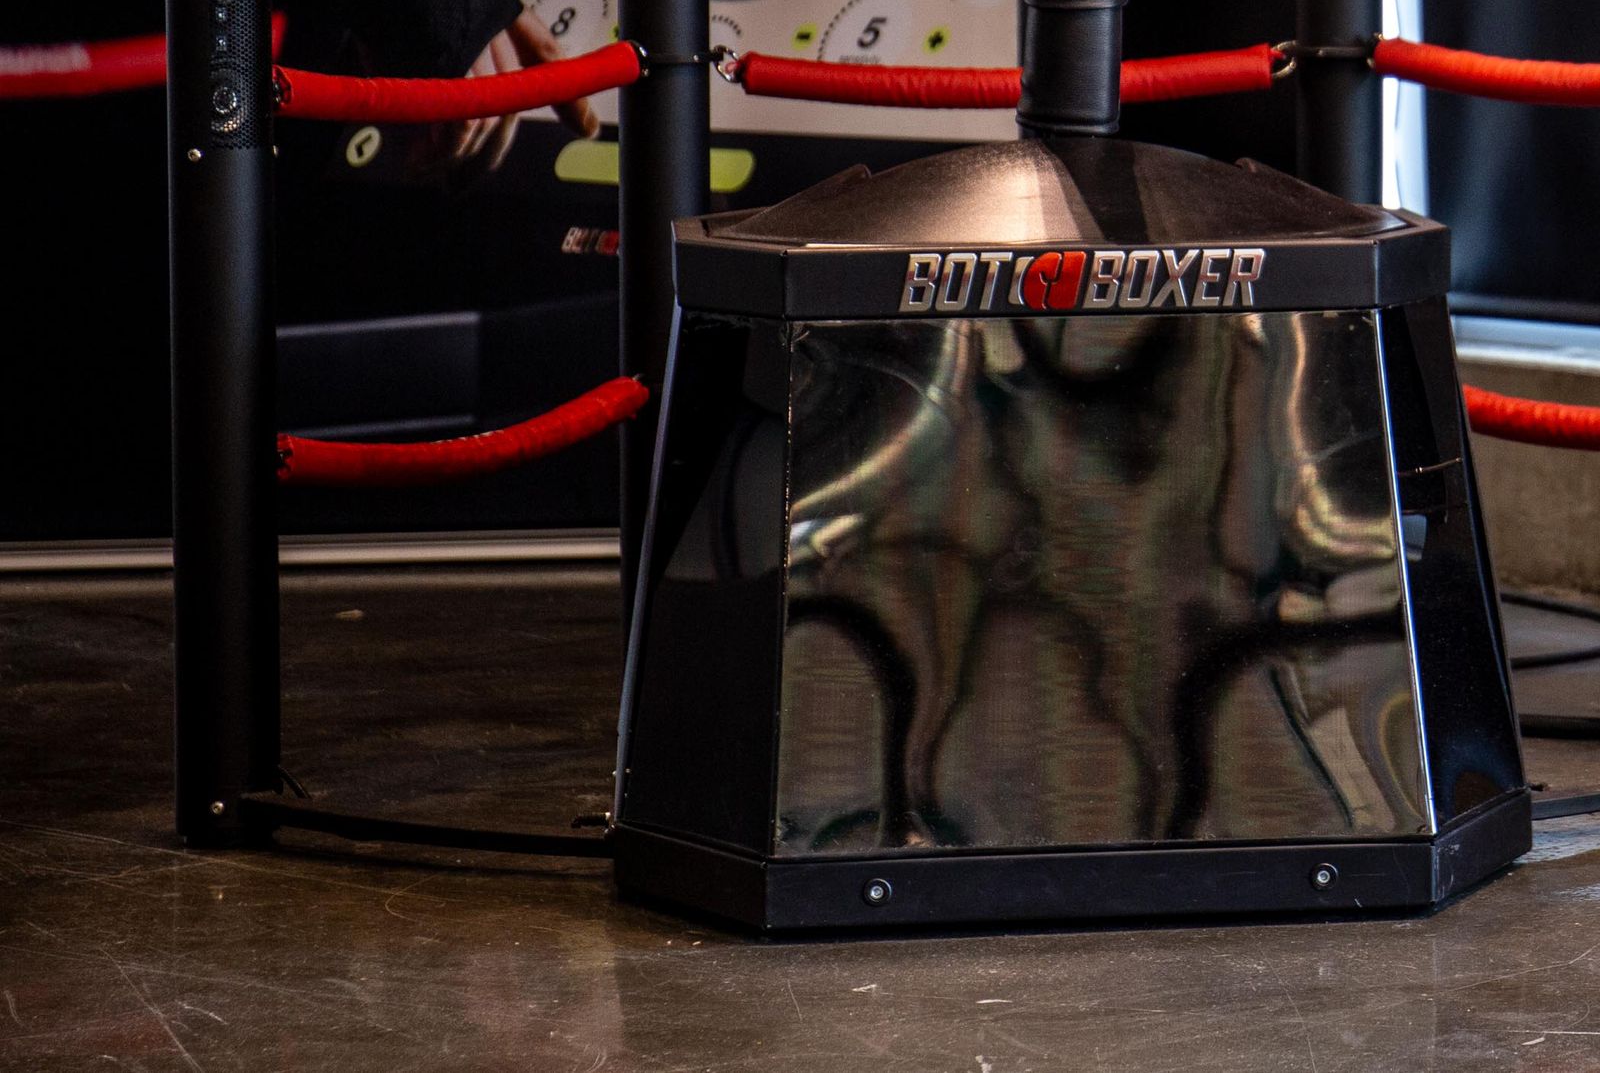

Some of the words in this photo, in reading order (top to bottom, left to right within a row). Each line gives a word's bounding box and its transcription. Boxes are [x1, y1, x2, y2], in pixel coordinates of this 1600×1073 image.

[550, 8, 575, 36] 8
[857, 17, 887, 49] 5
[900, 252, 1013, 311] BOT
[1082, 248, 1265, 308] BOXER
